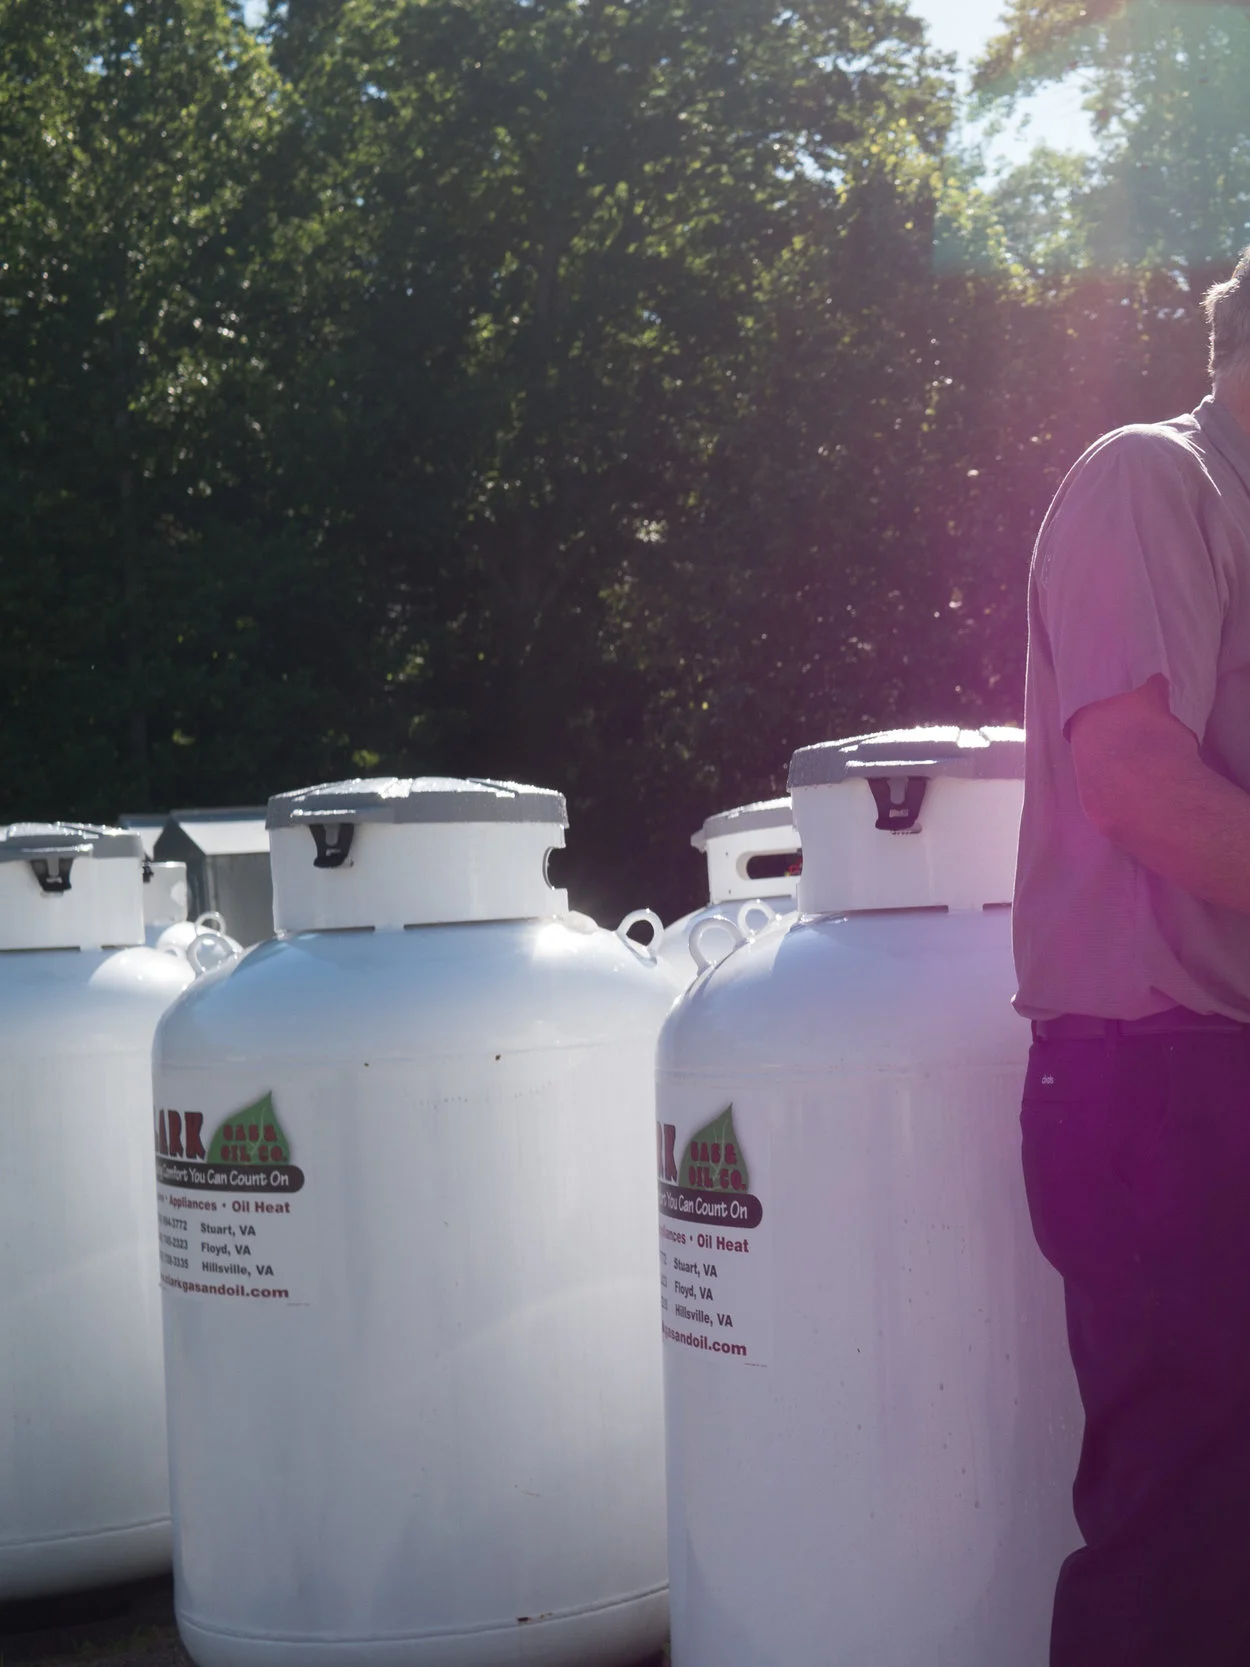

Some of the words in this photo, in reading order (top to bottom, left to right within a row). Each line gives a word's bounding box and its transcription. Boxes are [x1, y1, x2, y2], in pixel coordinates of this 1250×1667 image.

[155, 1108, 206, 1160] ARK
[221, 1146, 251, 1162] OIL
[189, 1168, 205, 1183] You
[207, 1169, 227, 1185] Can
[229, 1171, 267, 1186] Count
[270, 1171, 289, 1186] On
[689, 1165, 713, 1188] OIL
[170, 1195, 217, 1211] Appliances
[232, 1200, 250, 1213] Oil
[255, 1201, 291, 1214] Heat
[679, 1195, 694, 1213] Can
[695, 1197, 728, 1217] Count
[730, 1201, 748, 1219] On
[200, 1222, 236, 1237] Stuart,
[239, 1225, 256, 1236] VA
[201, 1242, 231, 1256] Floyd,
[235, 1245, 251, 1256] VA
[697, 1233, 712, 1249] Oil
[716, 1236, 749, 1253] Heat
[202, 1261, 251, 1277] Hillsville,
[256, 1265, 275, 1276] VA
[674, 1258, 700, 1278] Stuart,
[703, 1264, 718, 1277] VA
[675, 1281, 697, 1300] Floyd,
[699, 1286, 713, 1300] VA
[675, 1304, 713, 1327] Hillsville,
[717, 1313, 733, 1327] VA
